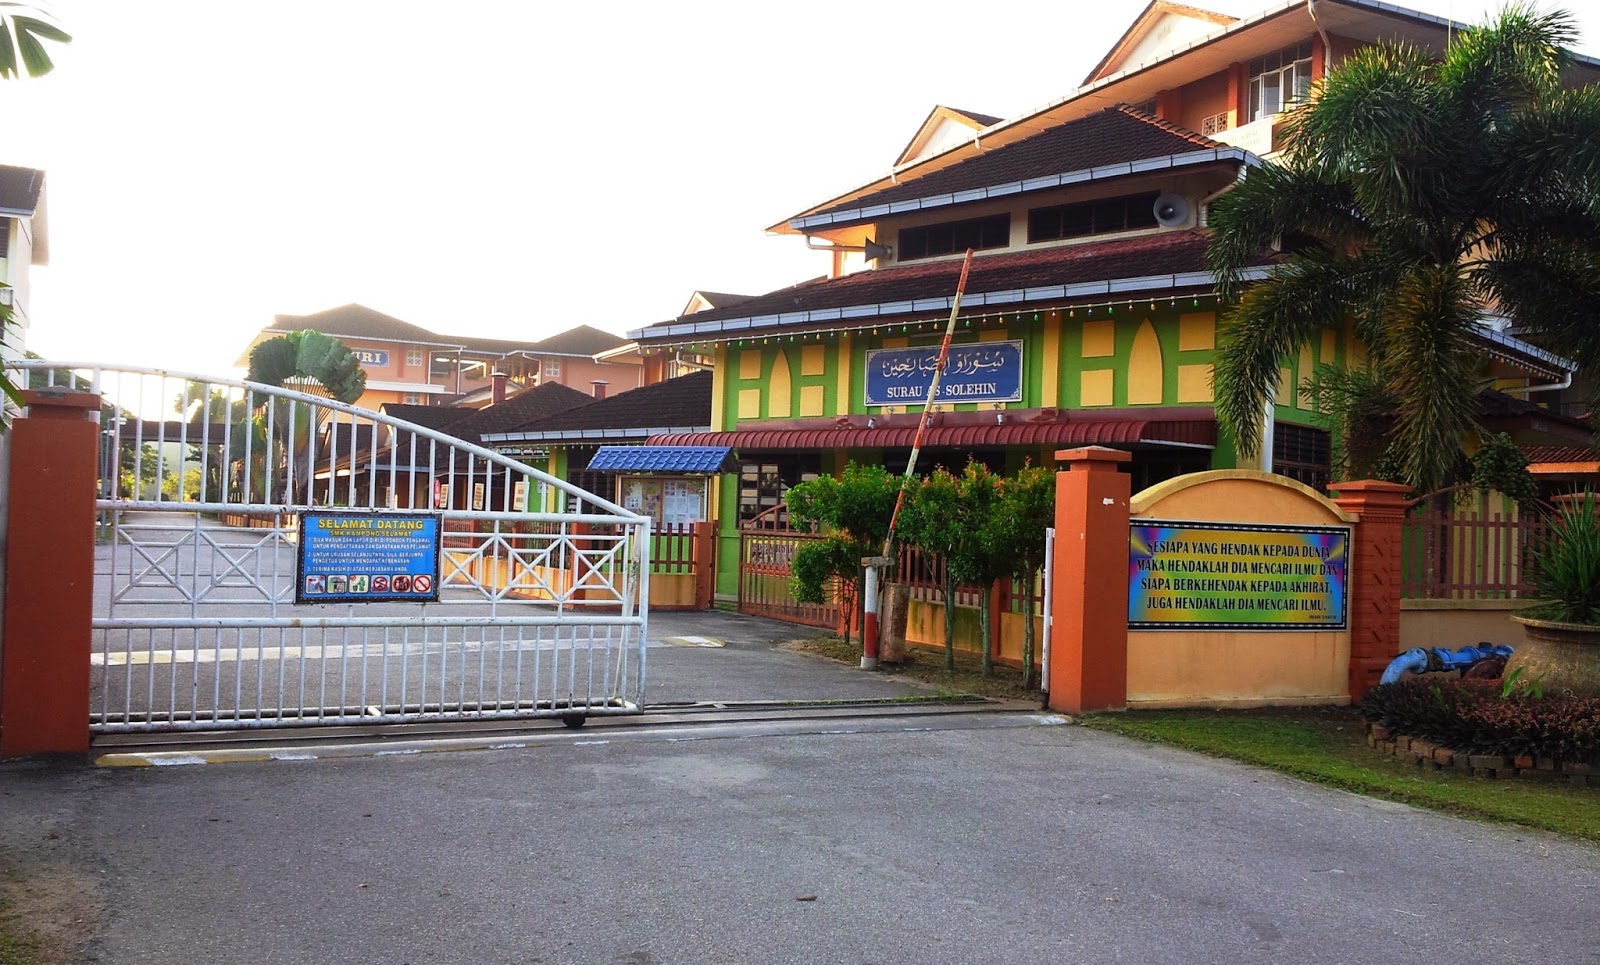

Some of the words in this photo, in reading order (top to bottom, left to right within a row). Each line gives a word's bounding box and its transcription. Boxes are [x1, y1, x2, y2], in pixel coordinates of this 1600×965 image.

[887, 385, 923, 398] SURAU
[318, 518, 374, 529] SELAMAT
[377, 519, 424, 530] DATANG
[1147, 540, 1189, 553] SESIAPA
[1192, 542, 1218, 555] YANG
[1220, 543, 1260, 556] HENDAK
[1263, 544, 1300, 557] KEPADA
[1302, 545, 1330, 558] DUNIA
[1137, 559, 1165, 572] MAKA
[1167, 560, 1228, 573] HENDAKLAH
[1231, 561, 1248, 574] DIA
[1250, 562, 1292, 575] MENCARI
[1294, 563, 1317, 575] ILMU
[1319, 564, 1338, 576] DAN
[1141, 577, 1171, 591] SIAPA
[1173, 578, 1248, 592] BERKEHENDAK
[1250, 580, 1288, 593] KEPADA
[1290, 581, 1333, 594] AKHIRAT,
[1147, 596, 1172, 609] JUGA
[1175, 597, 1235, 610] HENDAKLAH
[1238, 598, 1255, 610] DIA
[1257, 598, 1298, 611] MENCARI
[1301, 599, 1327, 611] ILMU.
